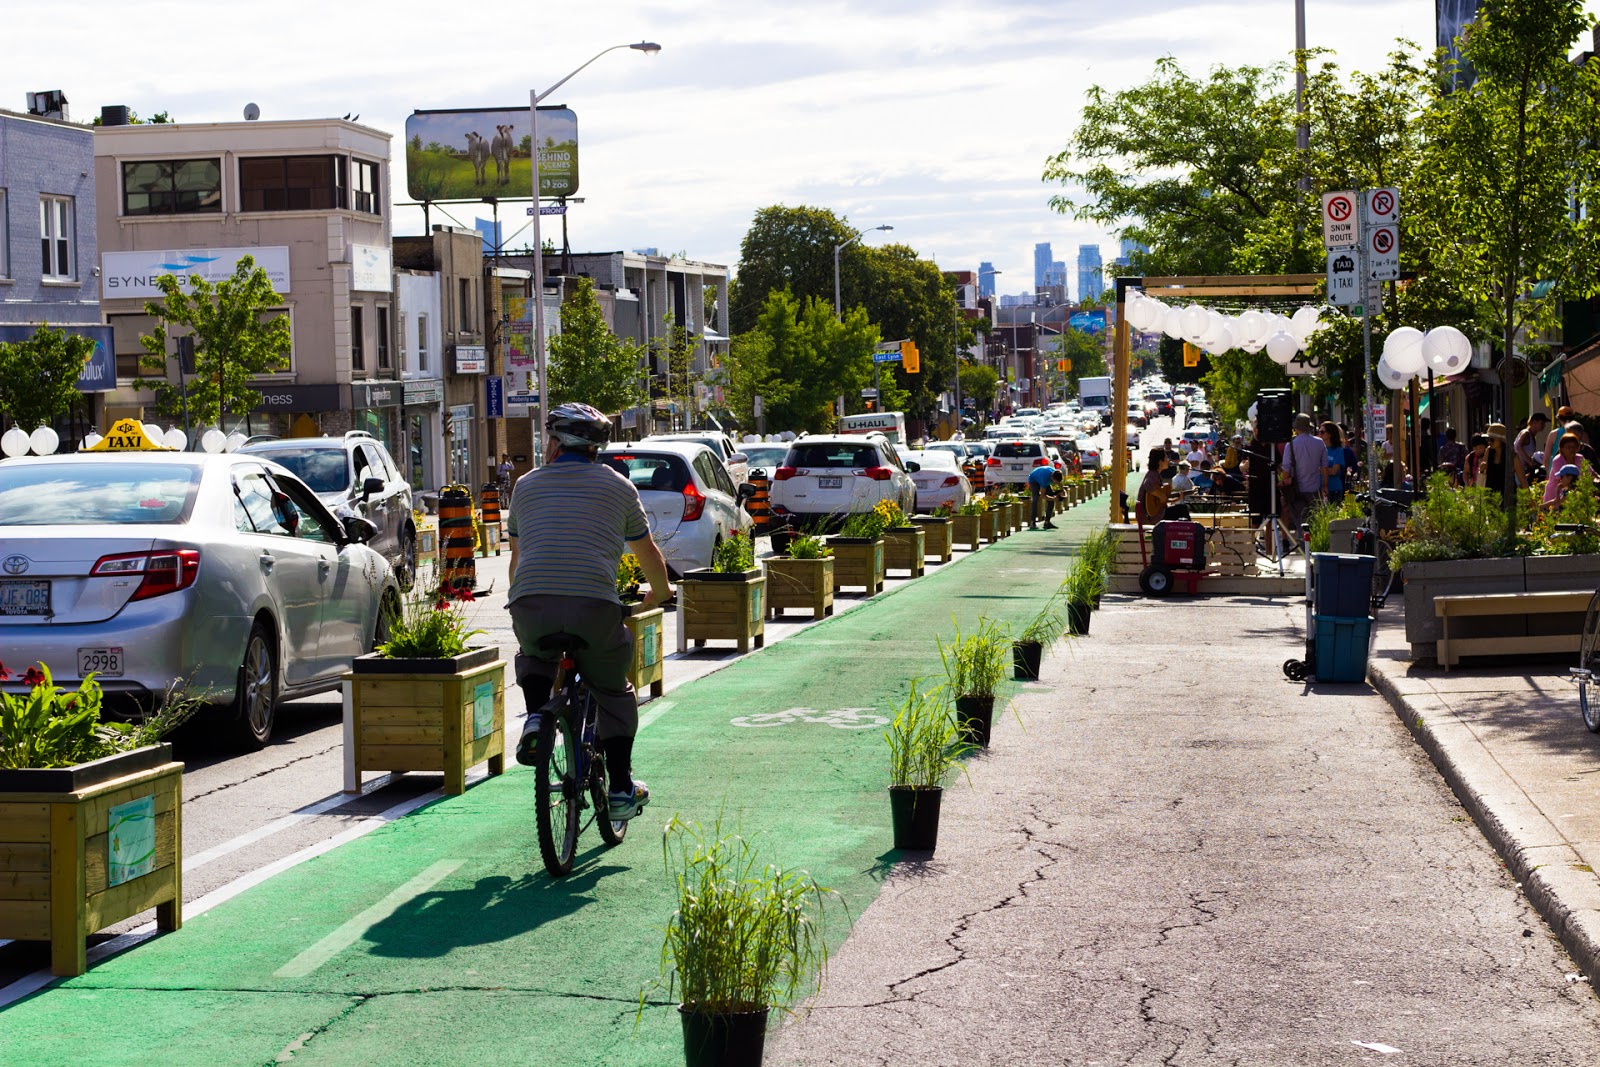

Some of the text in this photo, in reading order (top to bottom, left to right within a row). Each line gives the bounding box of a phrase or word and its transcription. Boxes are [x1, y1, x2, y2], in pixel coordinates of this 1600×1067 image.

[536, 152, 571, 161] BEHIND
[542, 161, 571, 170] SCENES
[527, 207, 566, 215] OTFRONT
[1330, 223, 1352, 232] SNOW
[1329, 233, 1353, 242] ROUTE
[1335, 260, 1352, 268] TAXI
[108, 274, 194, 288] SYNEG
[1333, 277, 1353, 289] 1 TAXI
[259, 391, 293, 405] lness
[848, 420, 887, 429] U-HAUL
[107, 436, 142, 448] TAXI
[83, 655, 118, 671] 2998
